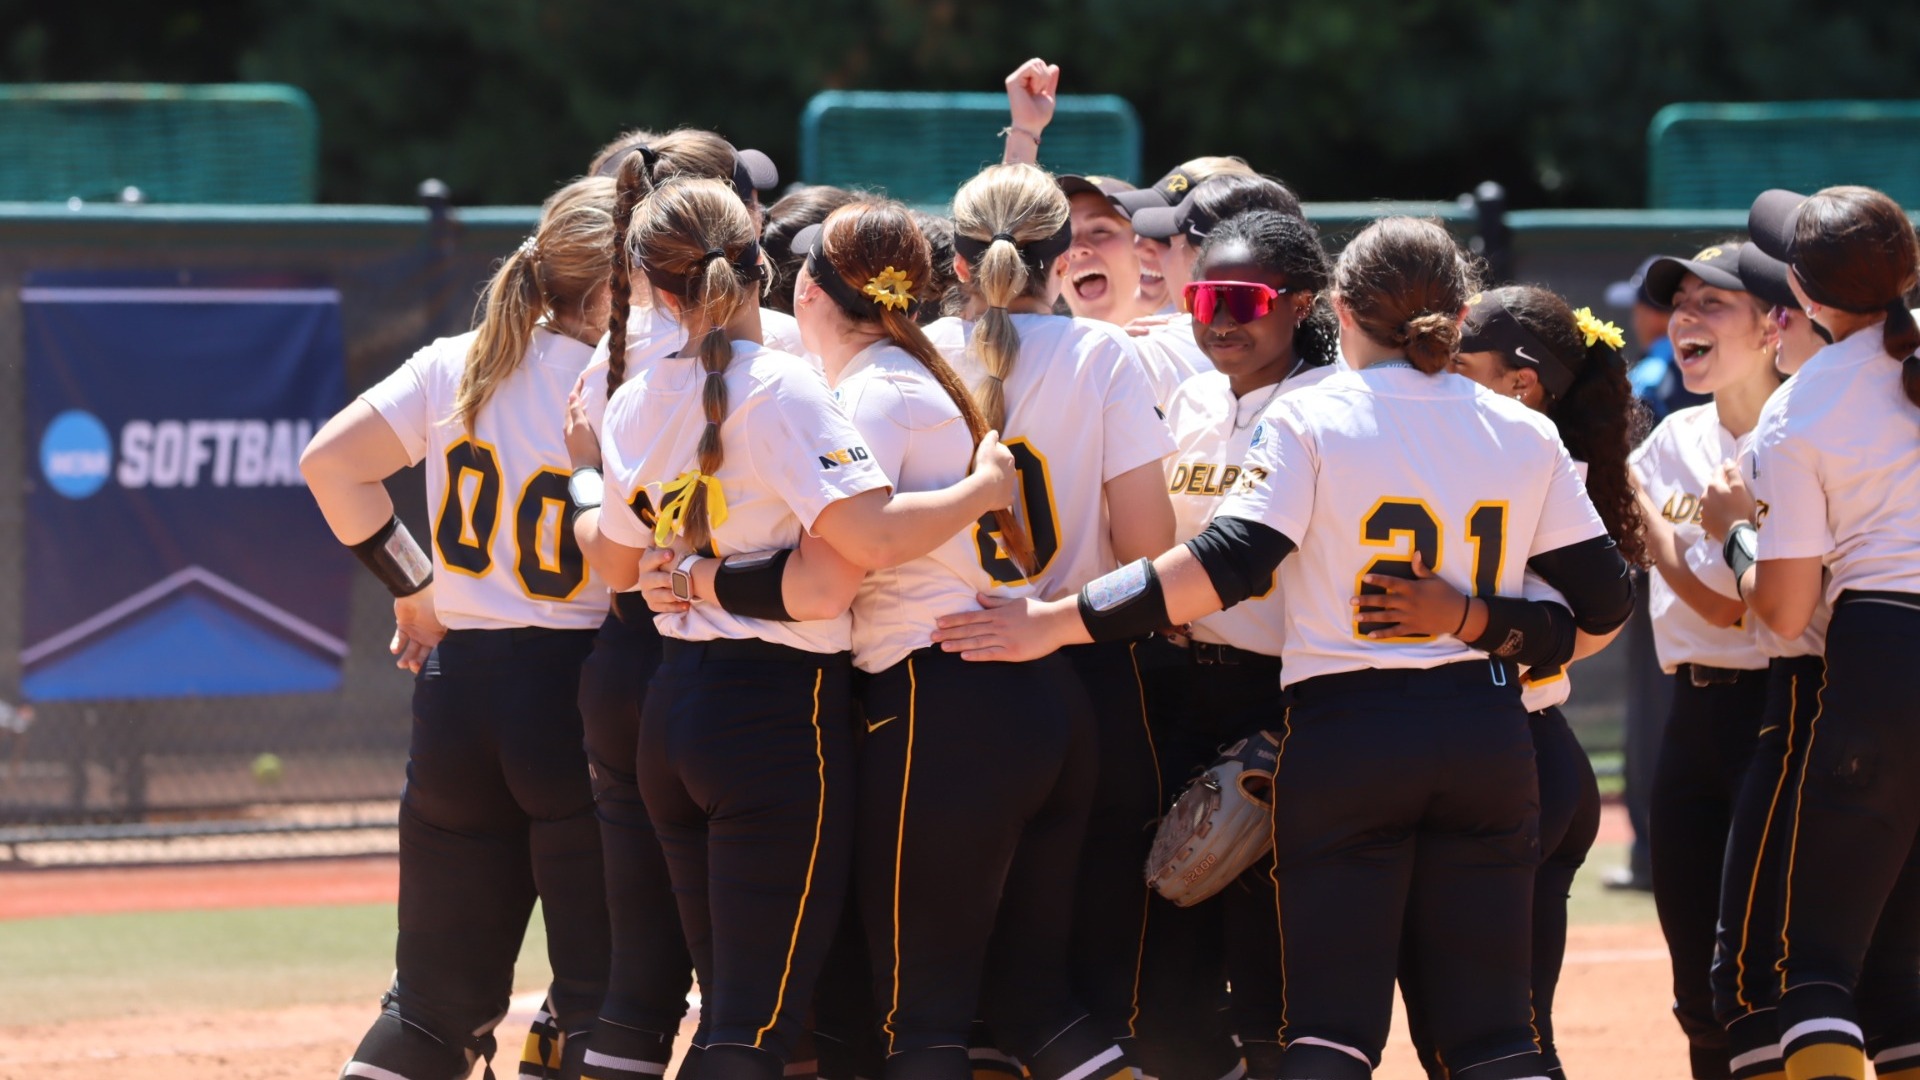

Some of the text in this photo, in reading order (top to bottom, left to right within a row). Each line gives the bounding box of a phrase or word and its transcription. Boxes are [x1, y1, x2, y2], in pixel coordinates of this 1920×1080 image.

[117, 419, 318, 488] SOFTBAL
[818, 446, 869, 470] NE10
[1168, 463, 1242, 497] DELP
[434, 434, 590, 601] 00
[1352, 495, 1509, 644] 21
